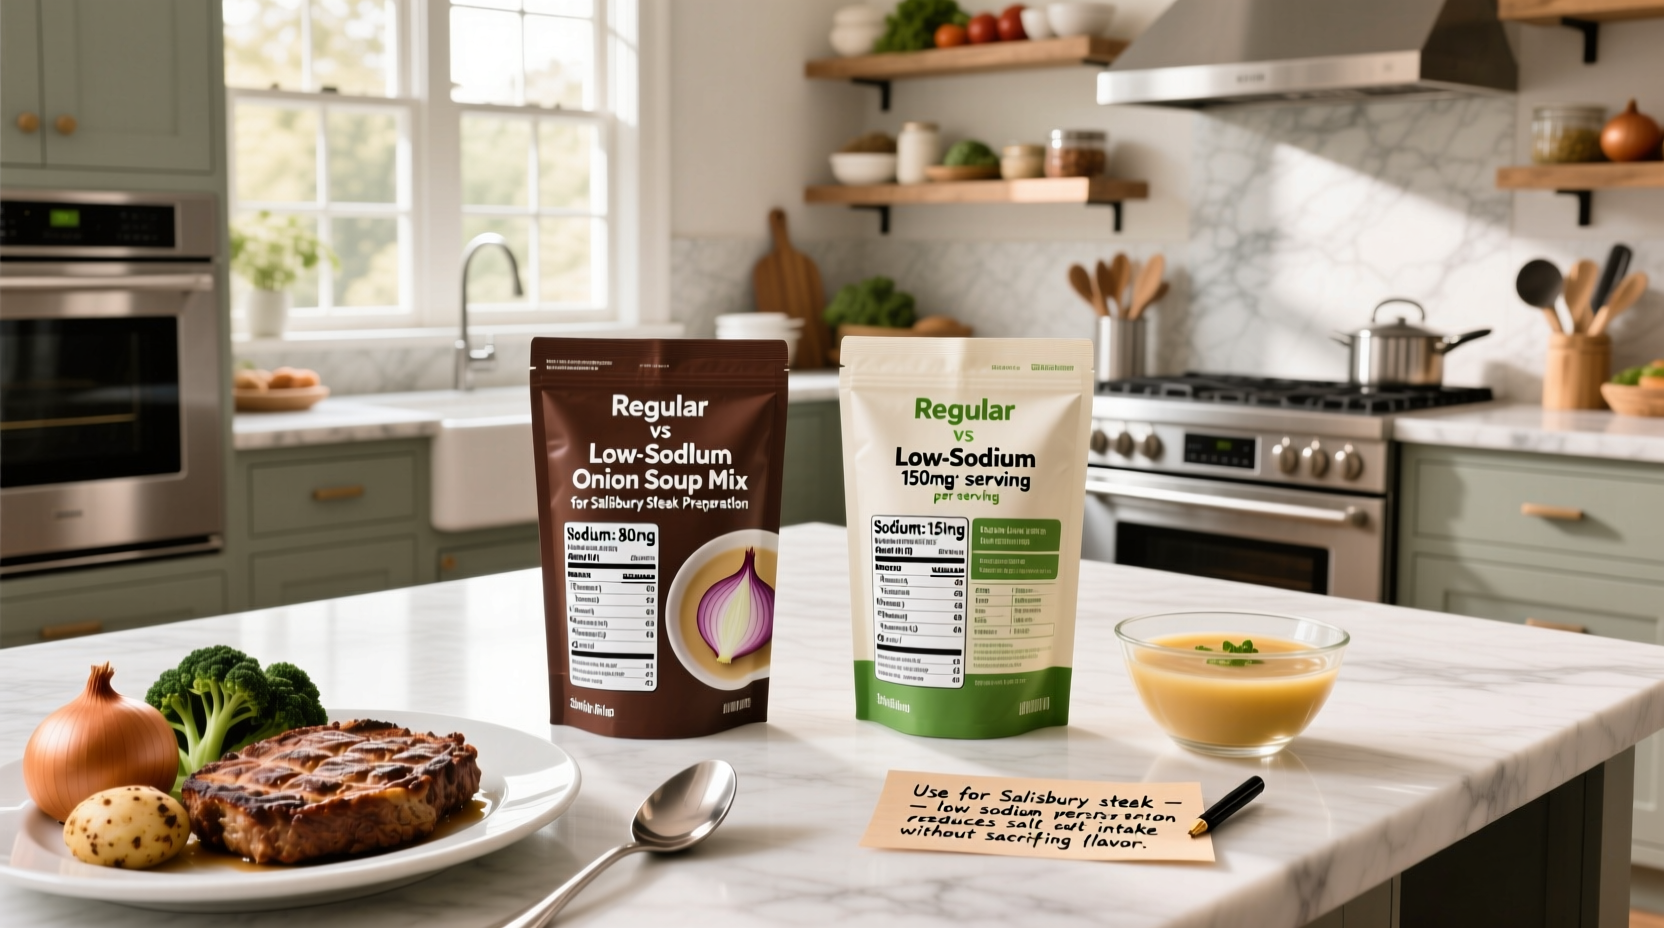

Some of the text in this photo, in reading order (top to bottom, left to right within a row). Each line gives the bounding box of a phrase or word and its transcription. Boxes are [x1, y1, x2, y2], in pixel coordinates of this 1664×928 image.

[612, 394, 708, 422] Regular
[915, 397, 1015, 425] Regular
[650, 425, 671, 439] vs
[953, 430, 974, 442] vs
[895, 447, 1036, 467] Low-Sodium
[572, 468, 748, 495] Onion Soup Mix
[965, 471, 1031, 492] serving
[571, 496, 589, 509] for
[913, 784, 949, 798] Use
[959, 786, 991, 801] for
[999, 789, 1089, 809] Salisbury
[937, 800, 970, 813] low
[900, 825, 976, 839] without
[1098, 822, 1158, 835] intake
